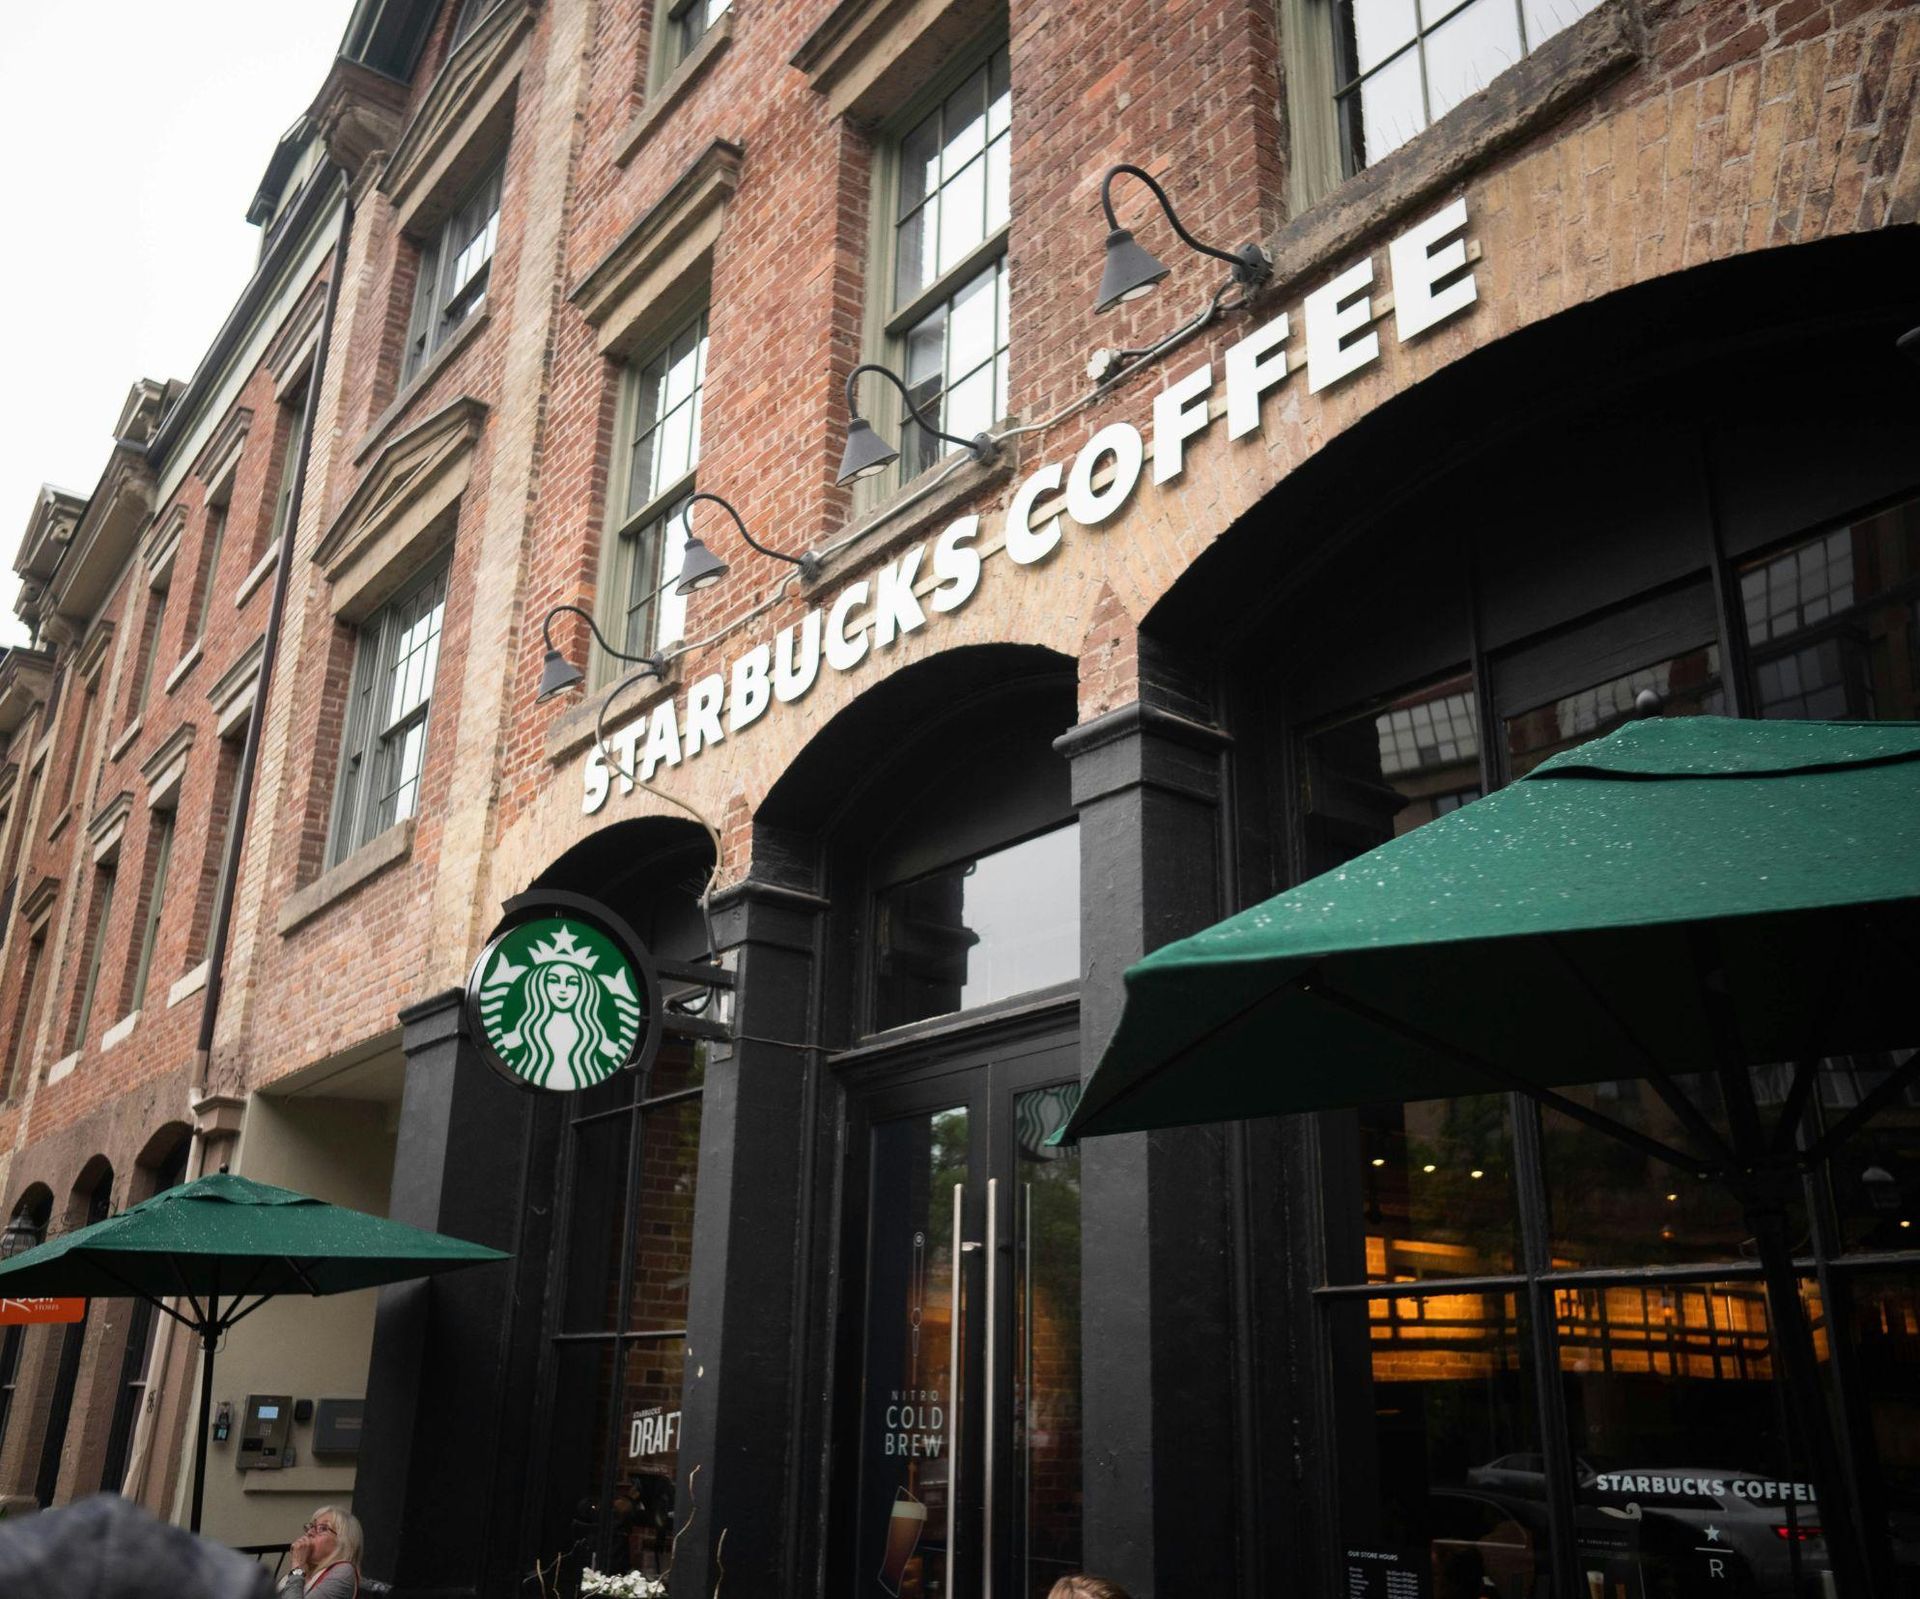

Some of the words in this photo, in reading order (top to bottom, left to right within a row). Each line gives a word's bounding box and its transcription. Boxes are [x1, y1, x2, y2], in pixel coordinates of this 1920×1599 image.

[580, 514, 982, 816] STARBUCKS
[1004, 197, 1478, 566] COFFEE
[891, 1390, 939, 1401] NITRO
[885, 1406, 943, 1430] COLD
[885, 1433, 943, 1457] BREW
[1596, 1474, 1726, 1497] STARBUCKS
[1709, 1559, 1725, 1578] R
